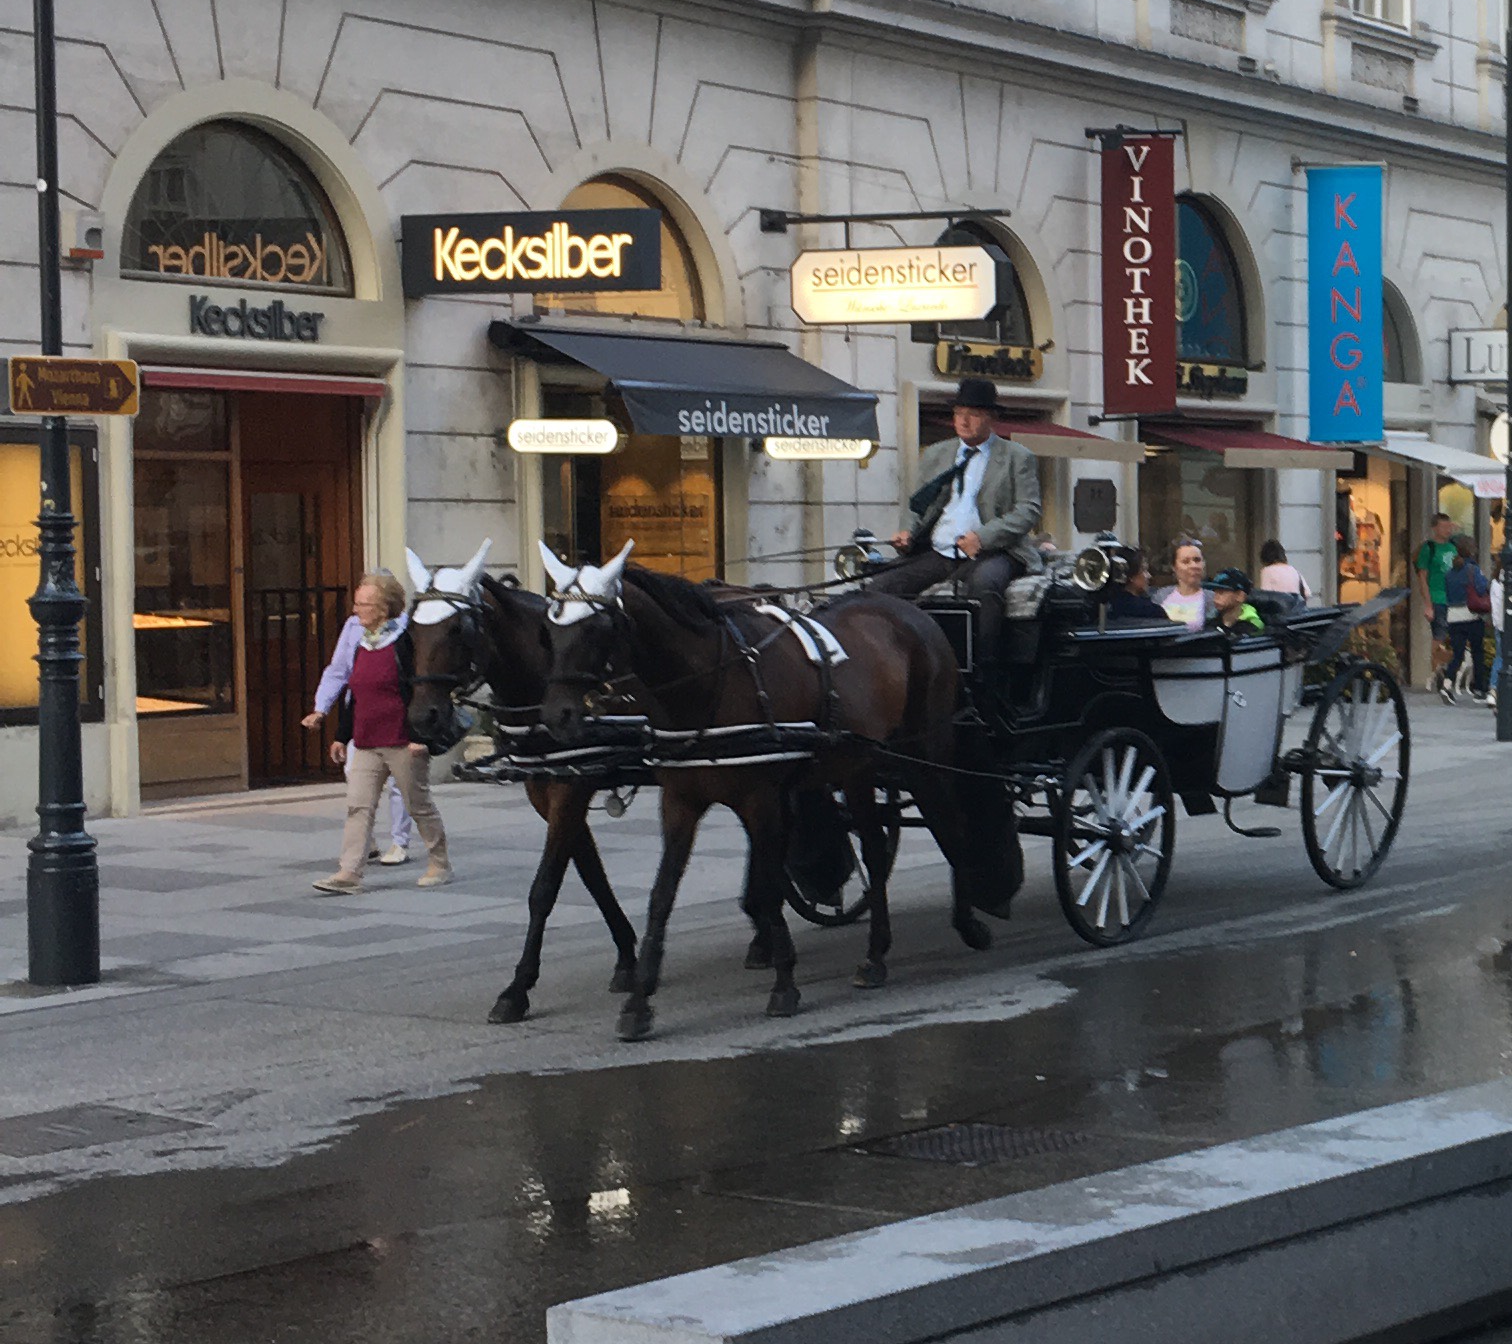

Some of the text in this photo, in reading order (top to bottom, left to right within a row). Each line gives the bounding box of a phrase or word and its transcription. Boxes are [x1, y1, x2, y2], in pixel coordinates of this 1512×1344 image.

[433, 221, 633, 282] Kecksilber
[811, 251, 978, 287] seidensticker
[1122, 145, 1154, 386] VINOTHEK
[188, 294, 326, 342] Kecksilber
[517, 425, 609, 445] seidensticker
[678, 403, 830, 437] seidensticker
